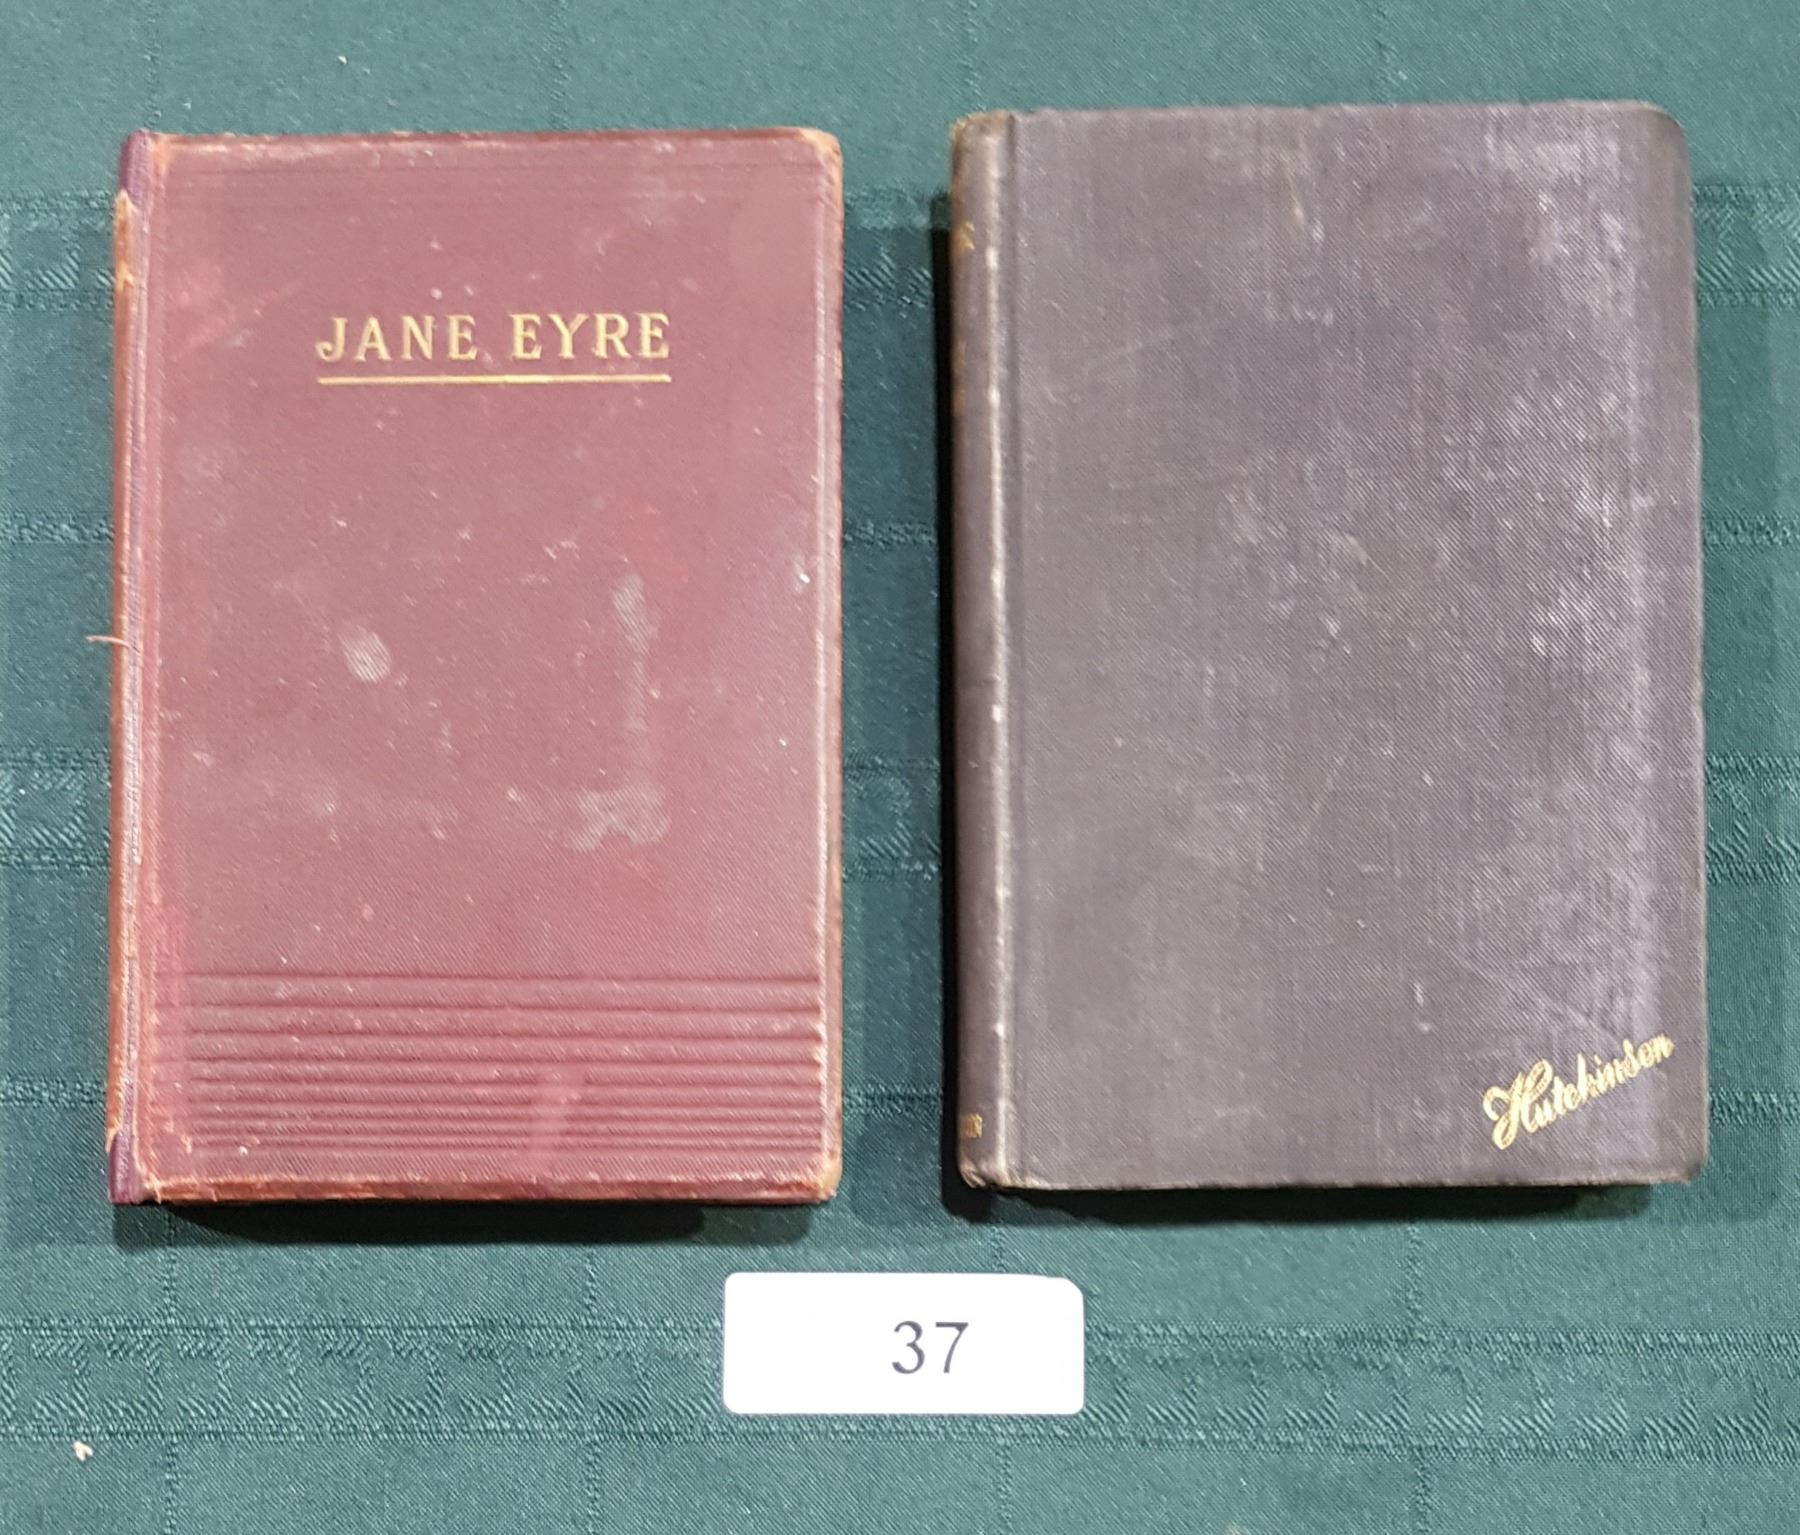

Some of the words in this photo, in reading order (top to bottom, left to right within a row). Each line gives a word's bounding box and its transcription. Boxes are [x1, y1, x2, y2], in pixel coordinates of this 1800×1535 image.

[315, 314, 478, 362] JANE
[509, 312, 671, 360] EYRE
[1482, 1033, 1675, 1150] Hutchinson
[891, 1320, 969, 1374] 37
